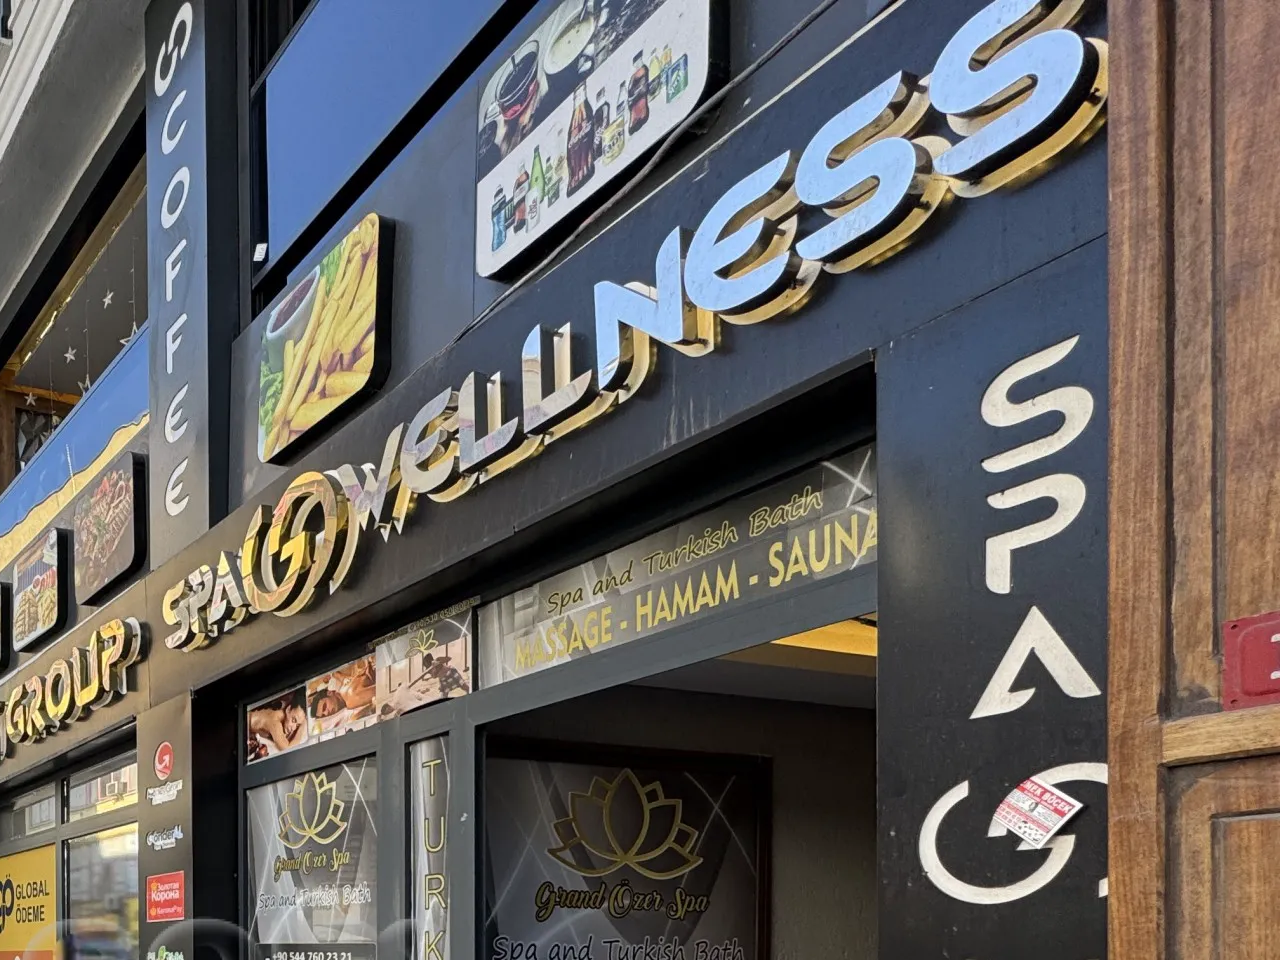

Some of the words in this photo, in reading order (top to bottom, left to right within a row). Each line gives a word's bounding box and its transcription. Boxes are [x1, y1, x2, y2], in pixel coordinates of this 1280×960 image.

[324, 0, 1108, 541] WELLNESS
[547, 589, 584, 615] Spa
[592, 565, 634, 596] and
[641, 521, 738, 576] Turkish
[748, 485, 824, 537] Bath
[970, 334, 1102, 720] SPA
[162, 550, 251, 652] SPA
[514, 608, 612, 672] MASSAGE
[635, 560, 739, 633] HAMAM
[768, 506, 877, 588] SAUNA
[6, 617, 141, 744] GROUP
[15, 880, 50, 900] GLOBAL
[259, 893, 275, 909] Spa
[280, 887, 297, 907] and
[300, 884, 340, 907] Turkish
[343, 881, 372, 906] Bath
[329, 847, 351, 872] Spa
[15, 903, 46, 924] ÖDEME
[151, 890, 180, 903] Корона
[535, 881, 606, 922] Grand
[608, 880, 664, 919] Özer
[667, 886, 710, 920] Spa
